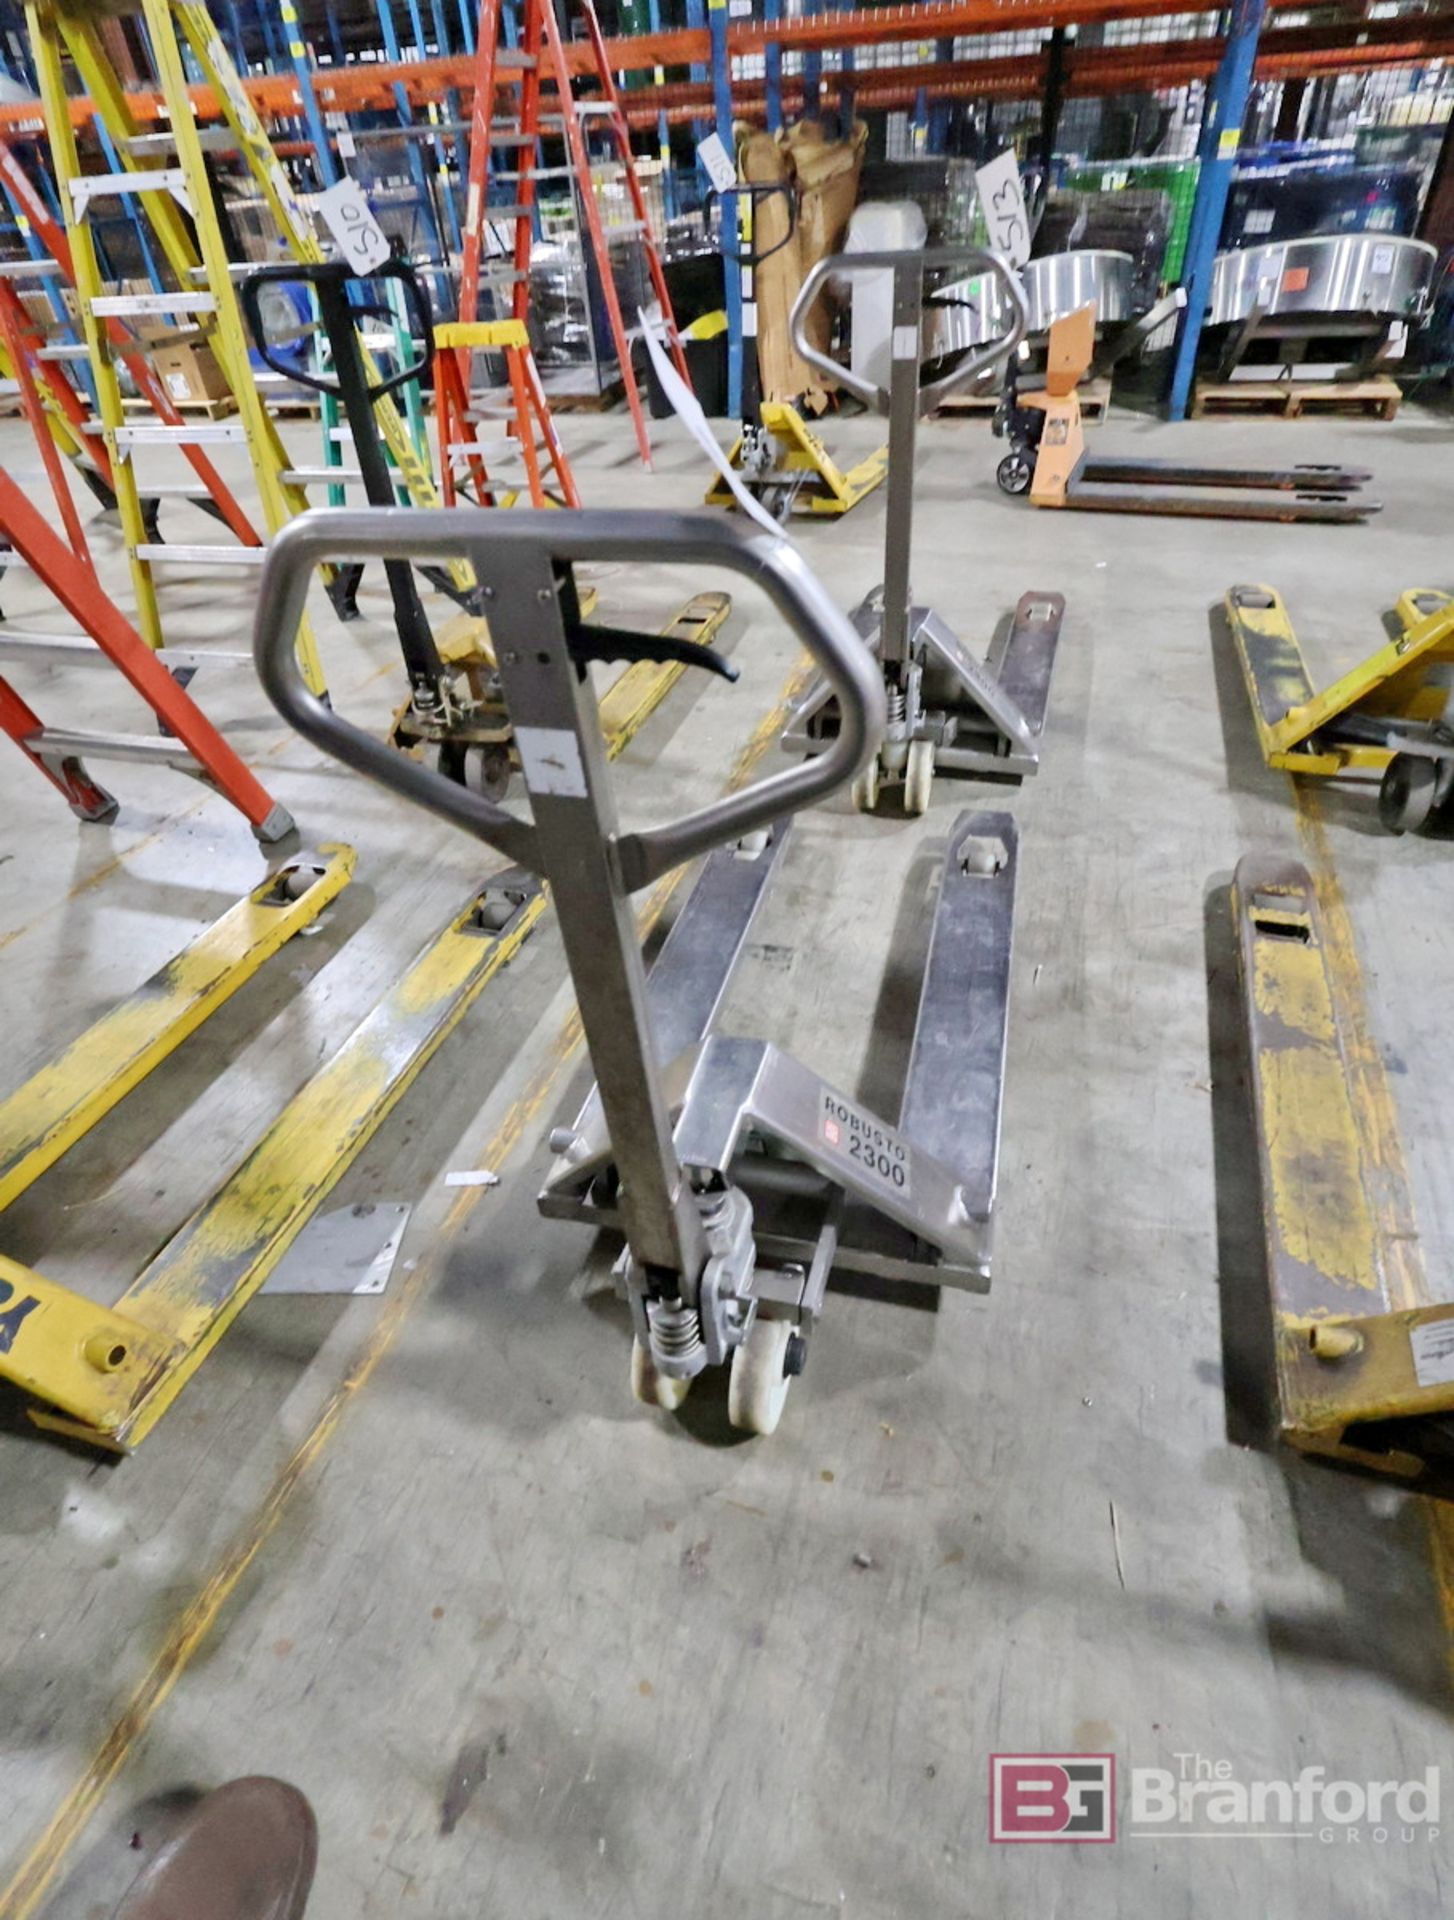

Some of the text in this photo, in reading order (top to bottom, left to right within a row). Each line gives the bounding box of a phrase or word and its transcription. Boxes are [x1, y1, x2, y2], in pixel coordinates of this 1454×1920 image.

[992, 178, 1024, 251] 513
[825, 1096, 905, 1161] ROBUSTO
[849, 1135, 905, 1187] 2300
